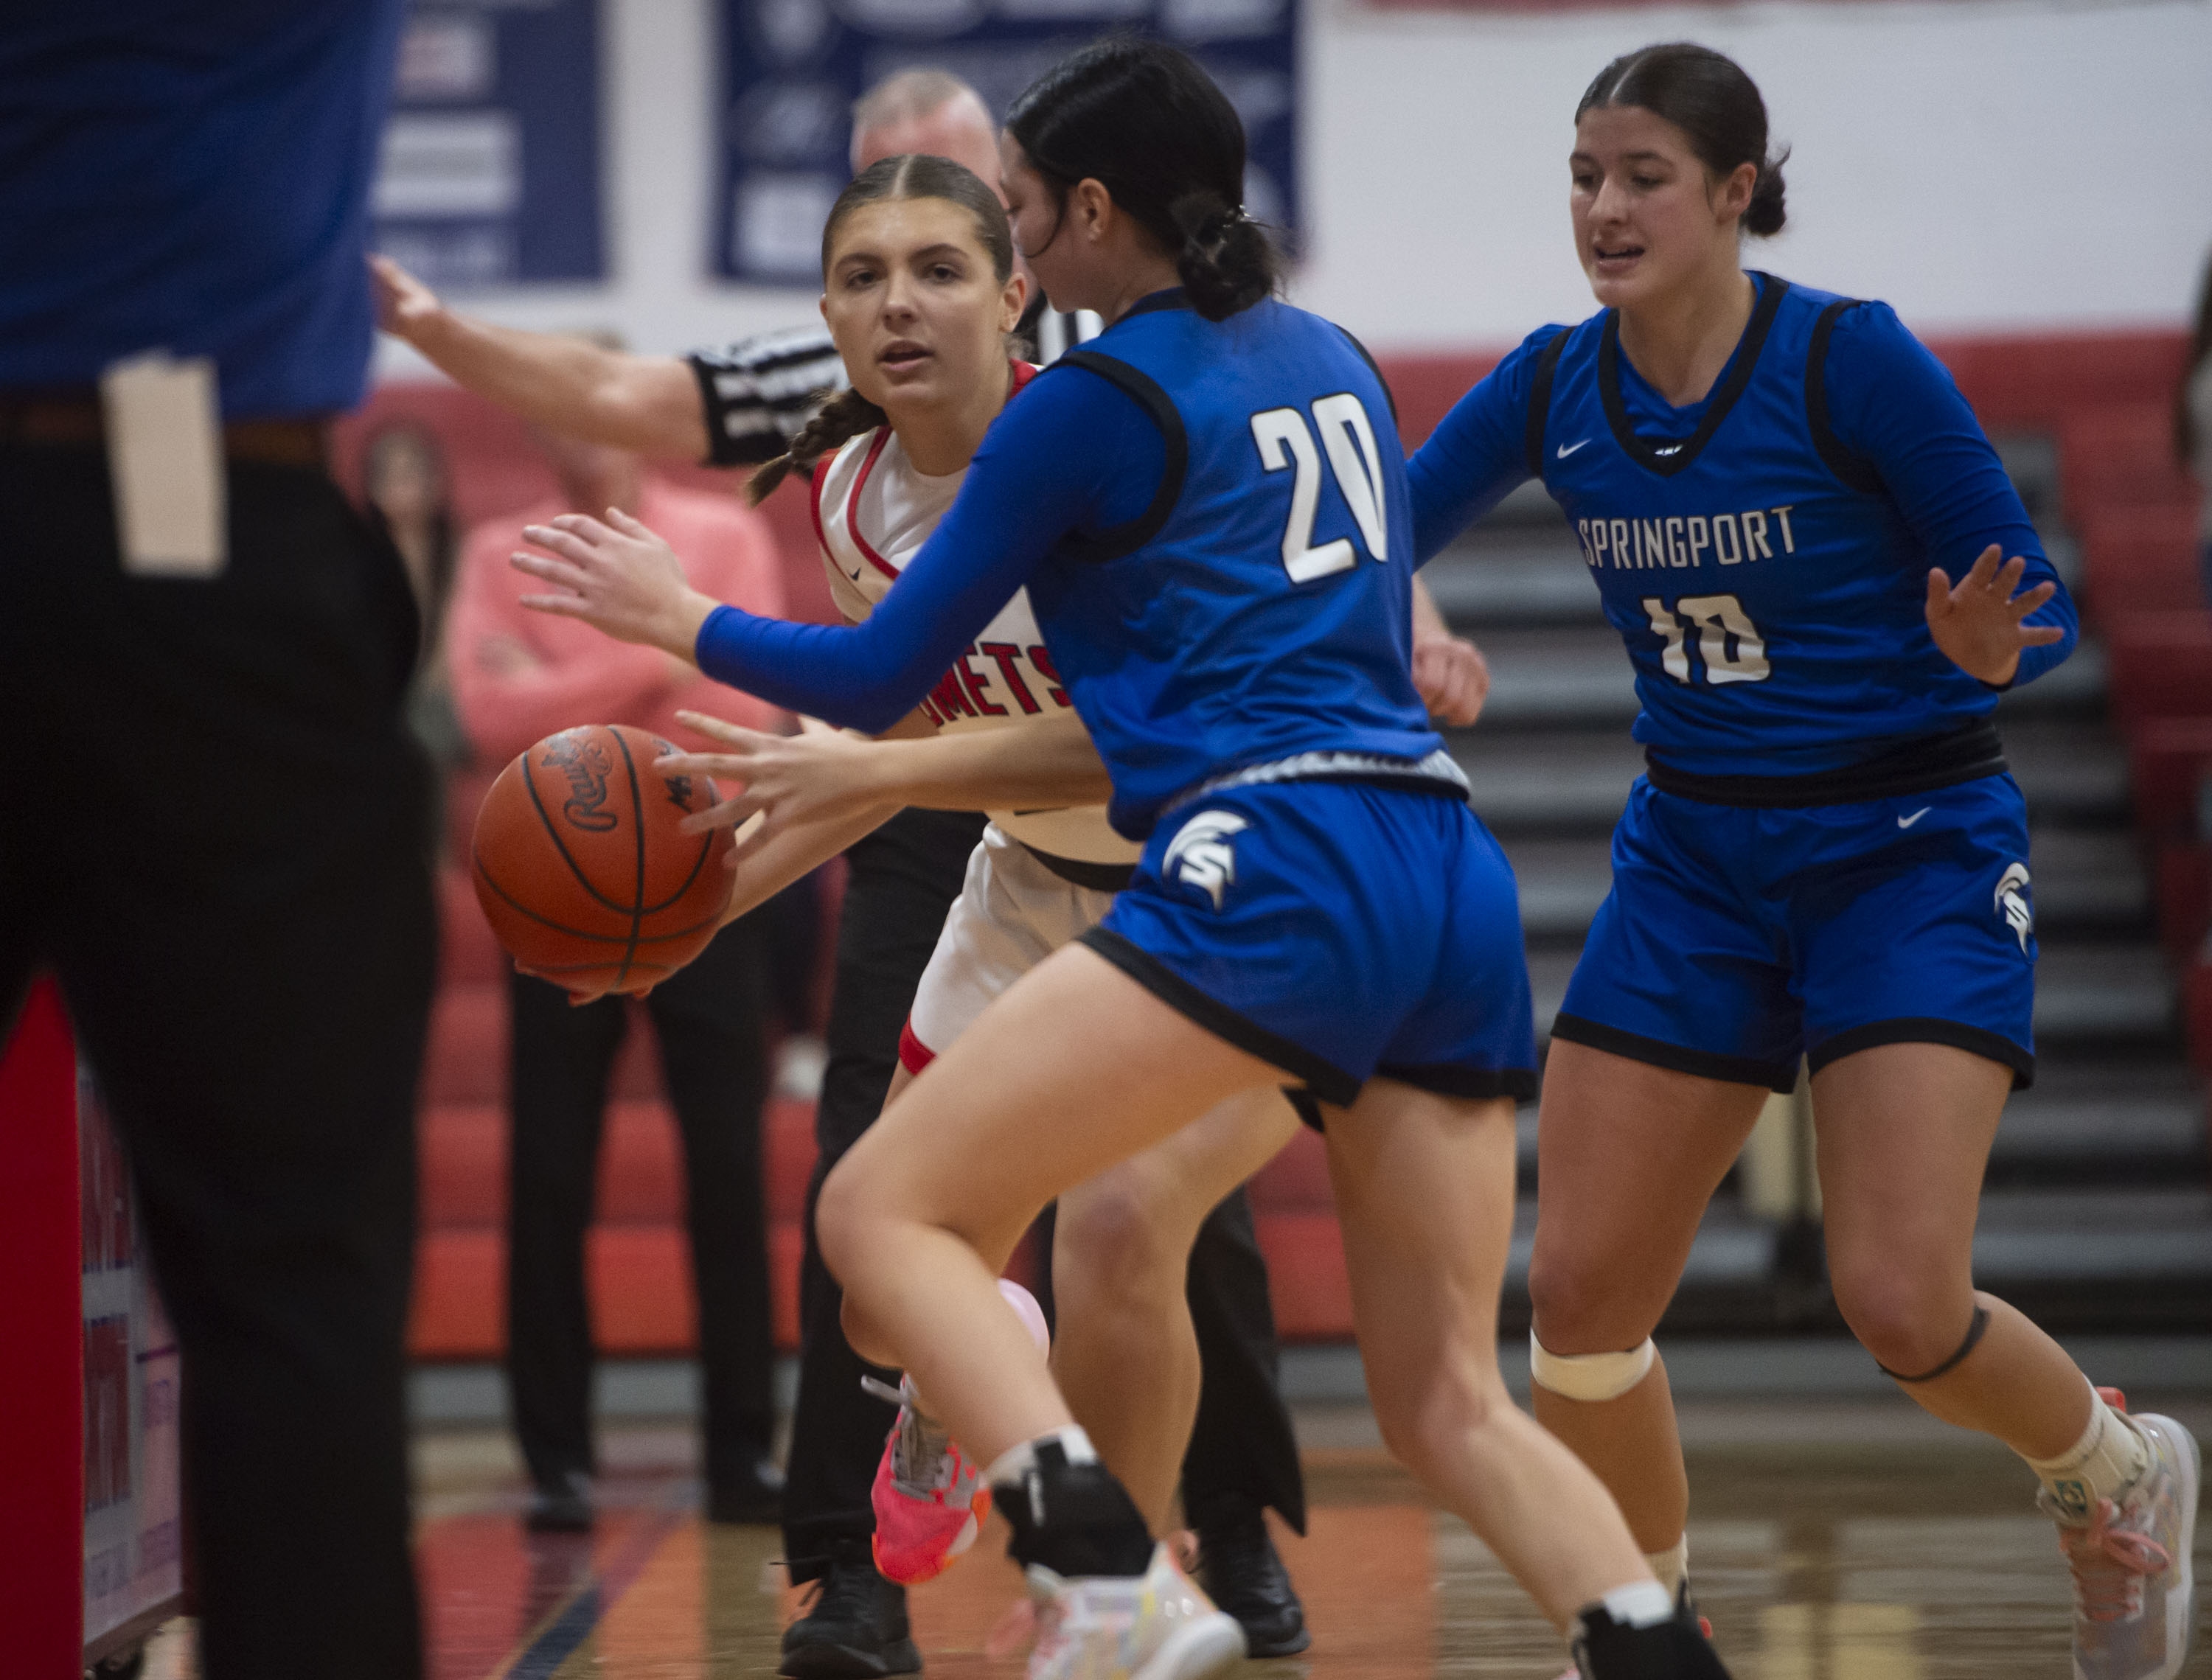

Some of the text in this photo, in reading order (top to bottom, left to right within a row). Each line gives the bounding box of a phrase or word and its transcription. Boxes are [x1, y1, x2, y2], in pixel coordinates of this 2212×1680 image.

[1250, 392, 1388, 583] 20
[1578, 505, 1795, 570] SPRINGPORT
[1641, 593, 1770, 685] 10
